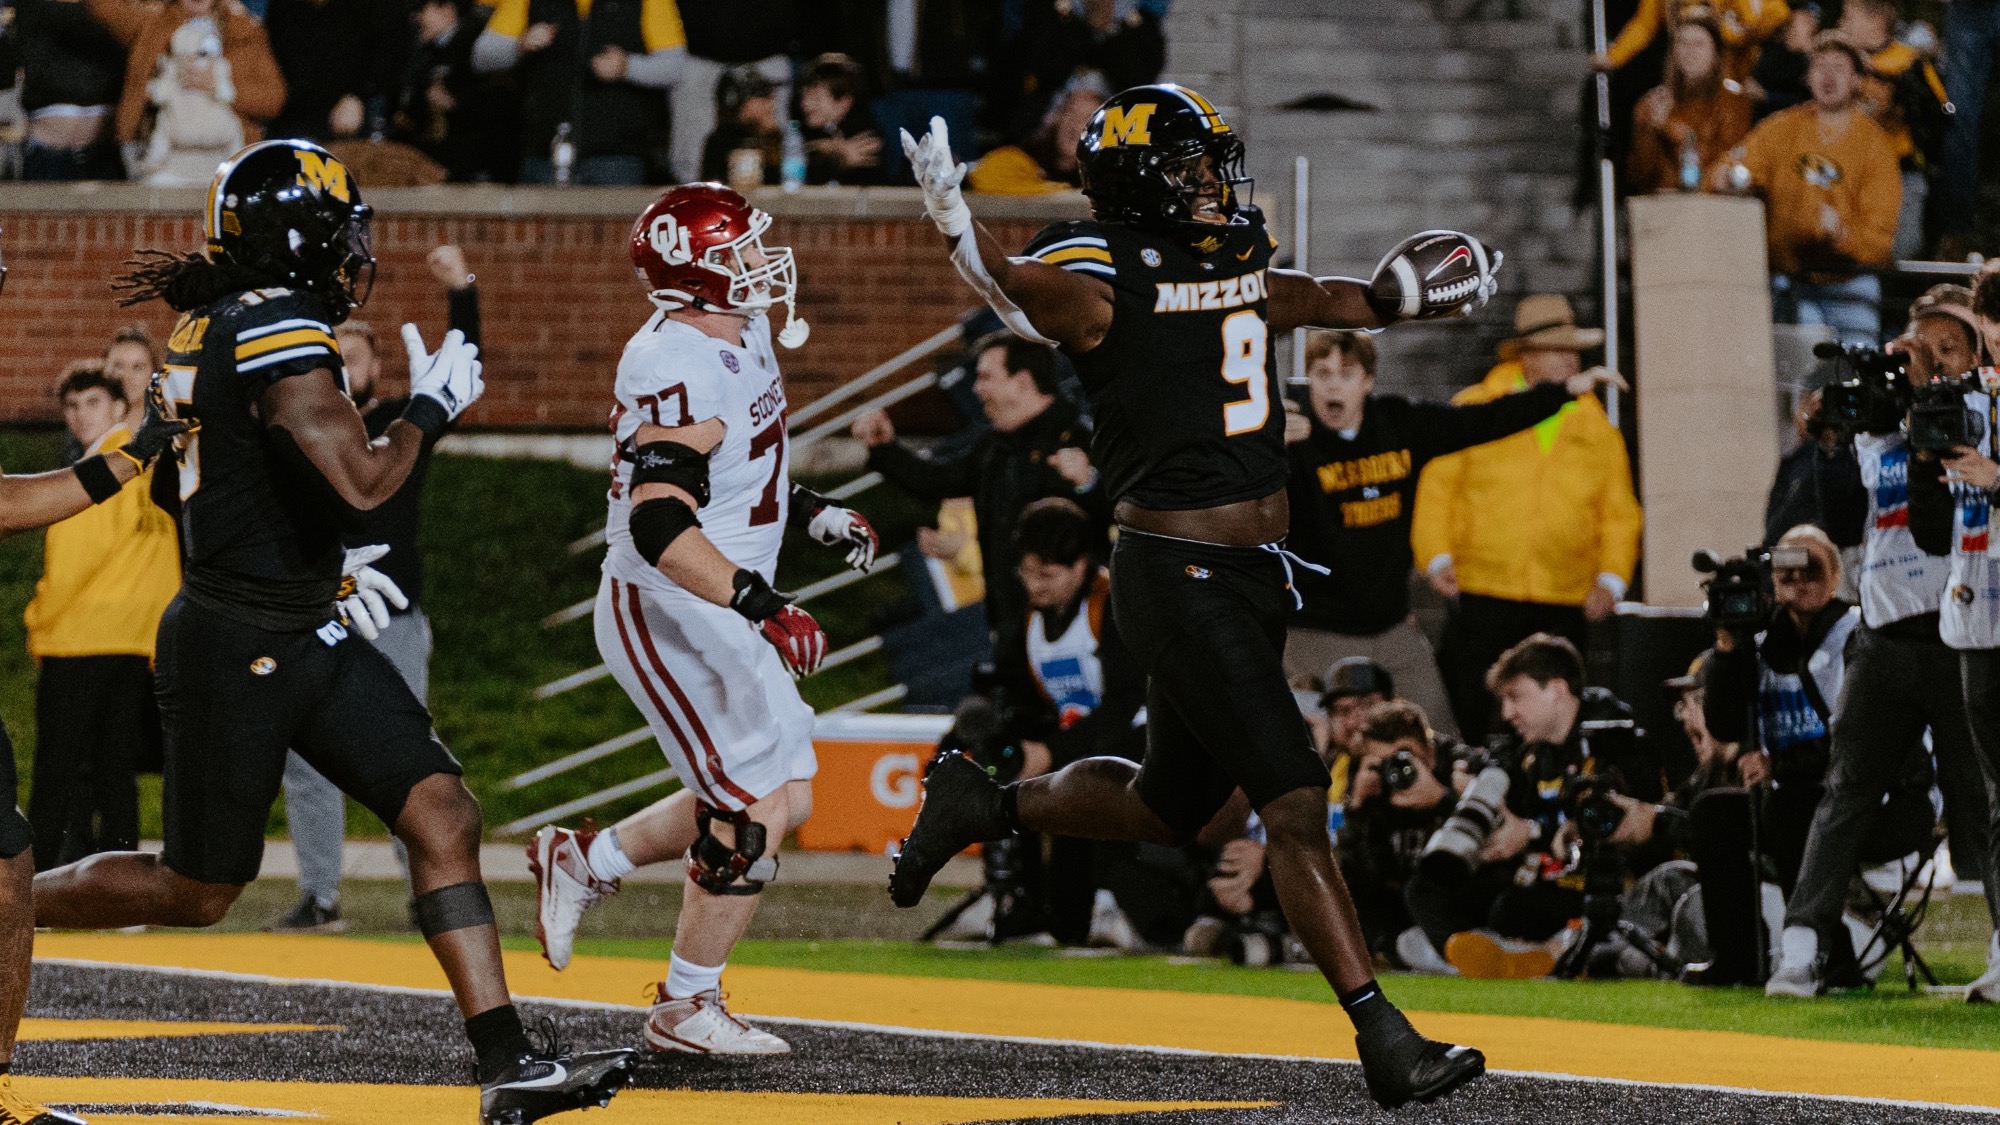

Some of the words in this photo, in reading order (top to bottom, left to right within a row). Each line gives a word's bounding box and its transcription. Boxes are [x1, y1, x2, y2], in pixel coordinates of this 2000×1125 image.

[1100, 103, 1157, 148] M
[294, 150, 350, 203] M
[1221, 309, 1270, 437] 9
[636, 381, 695, 428] 77
[748, 408, 787, 527] 7
[871, 753, 919, 808] G
